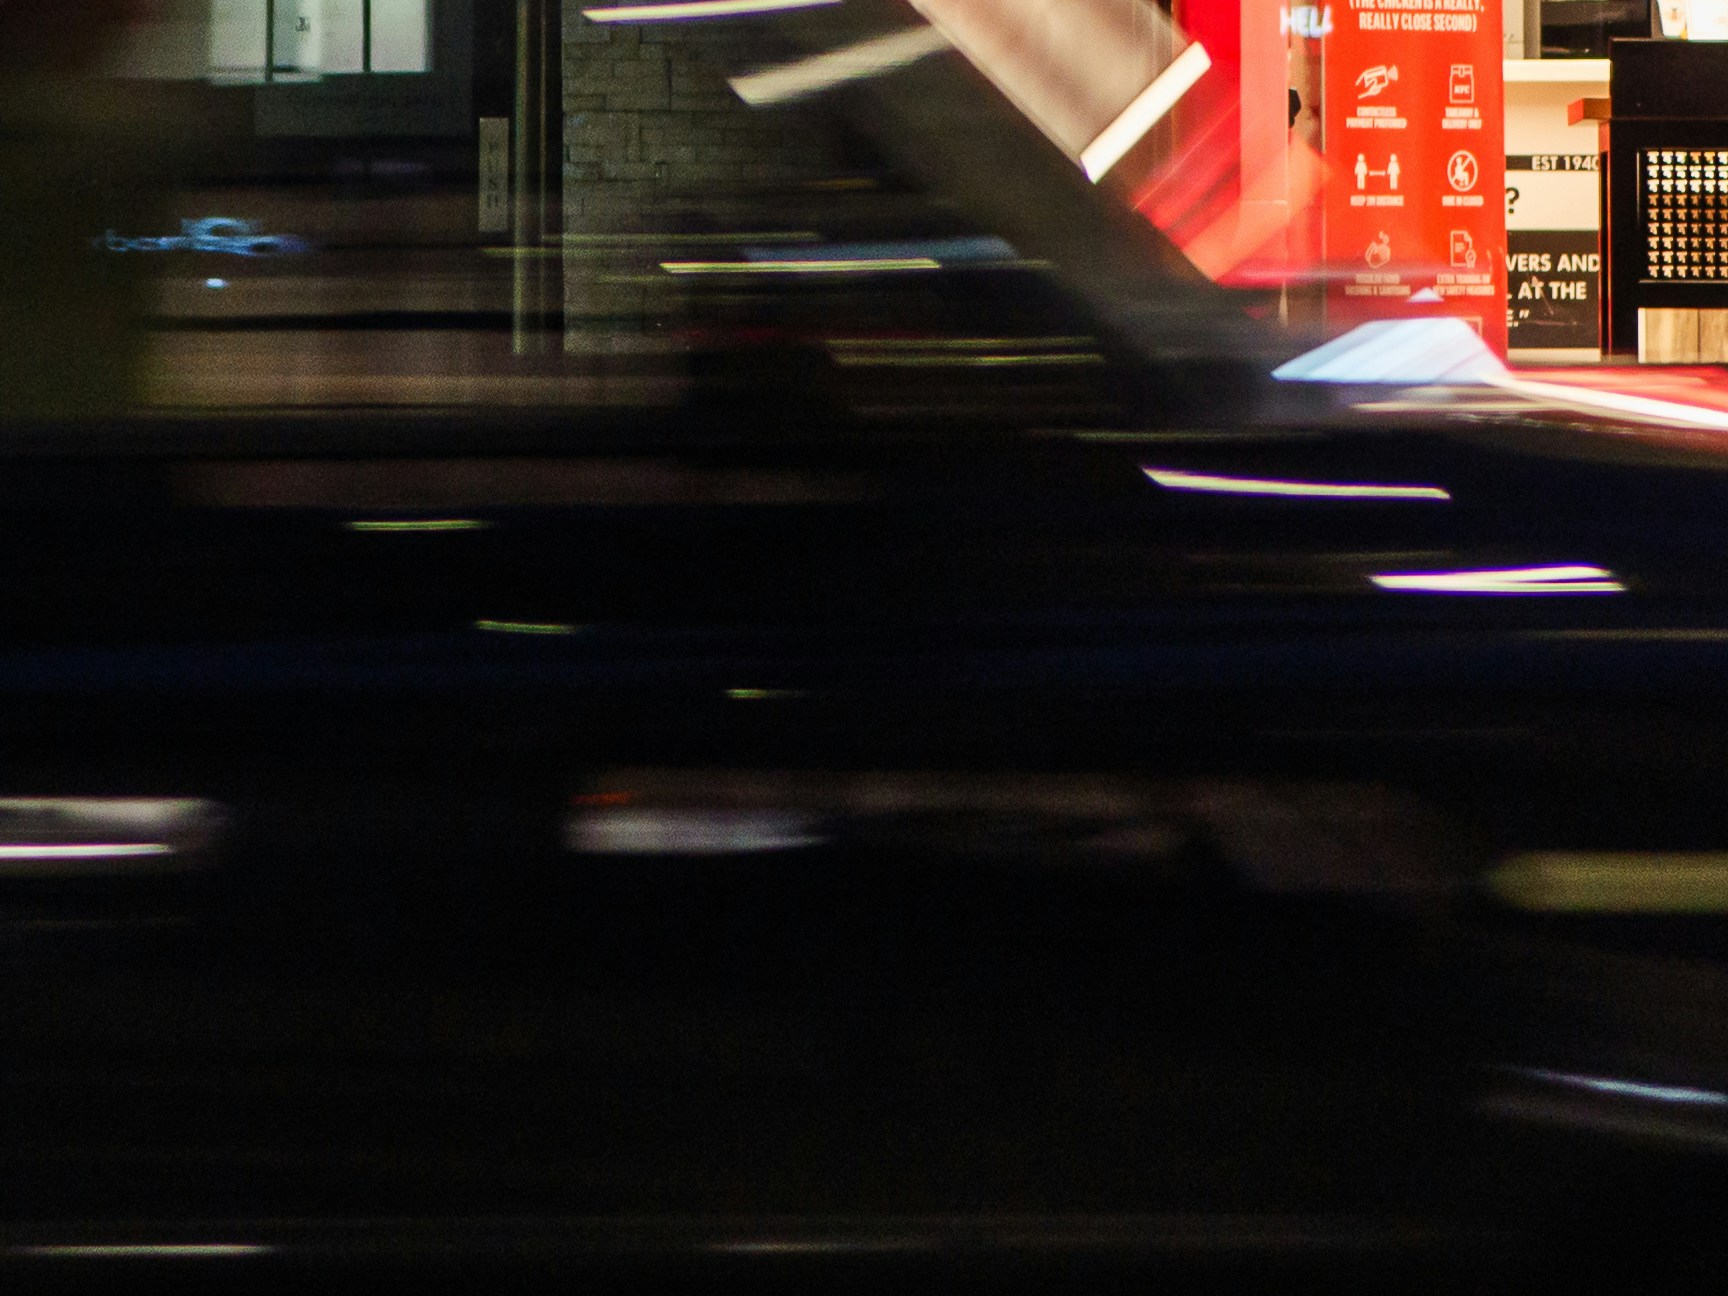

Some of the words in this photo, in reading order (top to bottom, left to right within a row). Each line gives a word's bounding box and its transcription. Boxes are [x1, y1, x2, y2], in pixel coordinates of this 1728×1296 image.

[1359, 11, 1399, 30] REALLY
[1401, 12, 1432, 31] CLOSE
[1434, 13, 1478, 32] SECOND)
[1531, 155, 1559, 171] EST
[1506, 253, 1552, 273] VERS
[1556, 253, 1601, 273] AND
[1518, 281, 1544, 300] AT
[1548, 281, 1588, 300] THE
